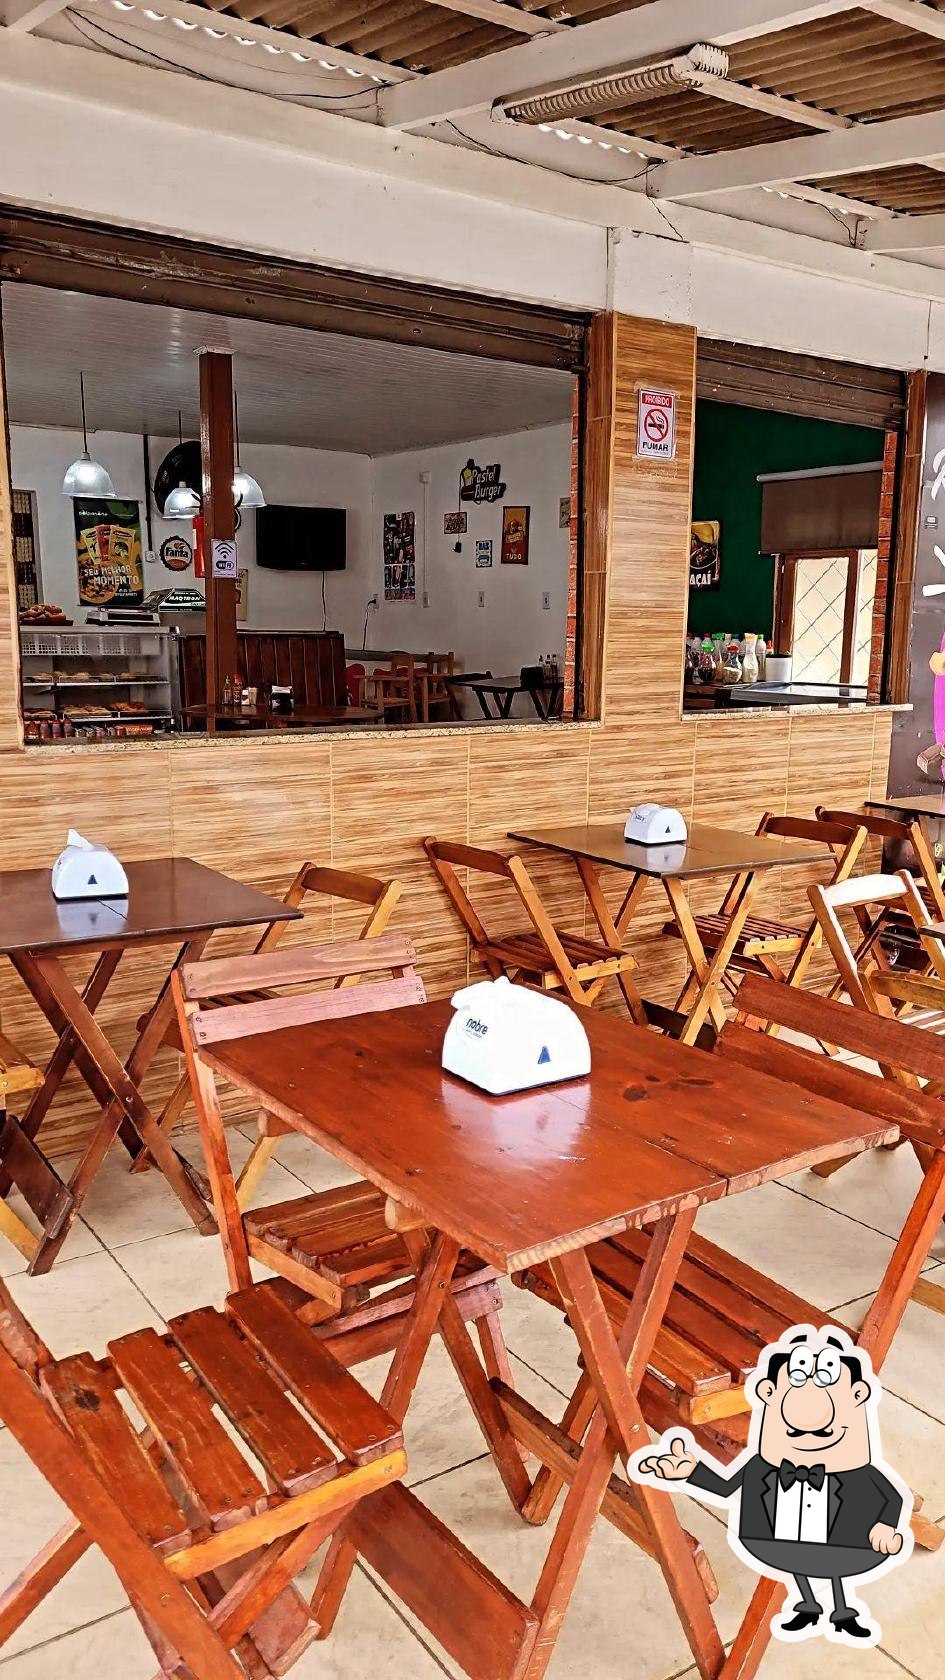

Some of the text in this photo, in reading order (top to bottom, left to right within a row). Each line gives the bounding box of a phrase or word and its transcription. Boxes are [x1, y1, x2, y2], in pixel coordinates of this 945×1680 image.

[642, 442, 669, 452] FUMAR
[471, 466, 496, 484] Pastel
[474, 484, 501, 500] Burger
[166, 546, 189, 558] Fanta
[84, 565, 131, 577] SEU MELHOR
[93, 575, 139, 585] MOMENTO
[690, 571, 711, 587] AÇAÍ
[465, 1018, 488, 1035] nobre
